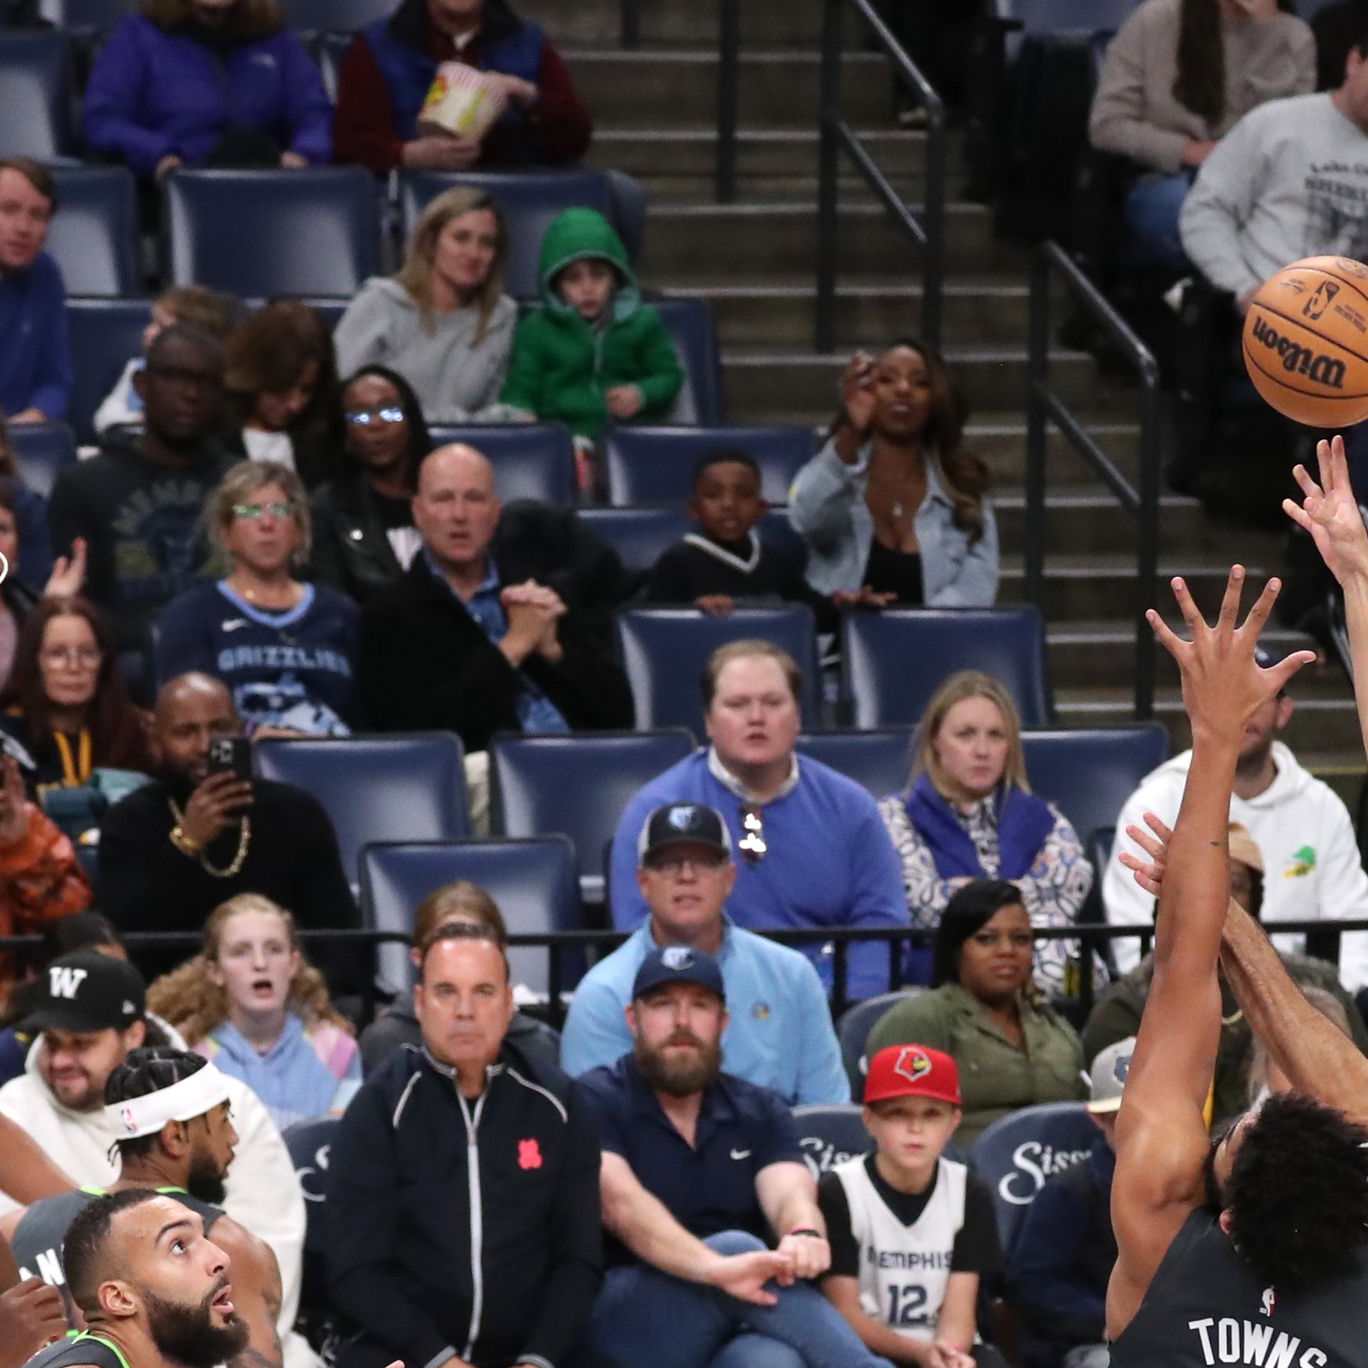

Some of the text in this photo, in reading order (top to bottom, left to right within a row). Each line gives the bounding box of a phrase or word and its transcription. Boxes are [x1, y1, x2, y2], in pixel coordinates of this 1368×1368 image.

[1252, 314, 1346, 389] Wilson
[49, 966, 88, 999] W
[888, 1284, 928, 1324] 12
